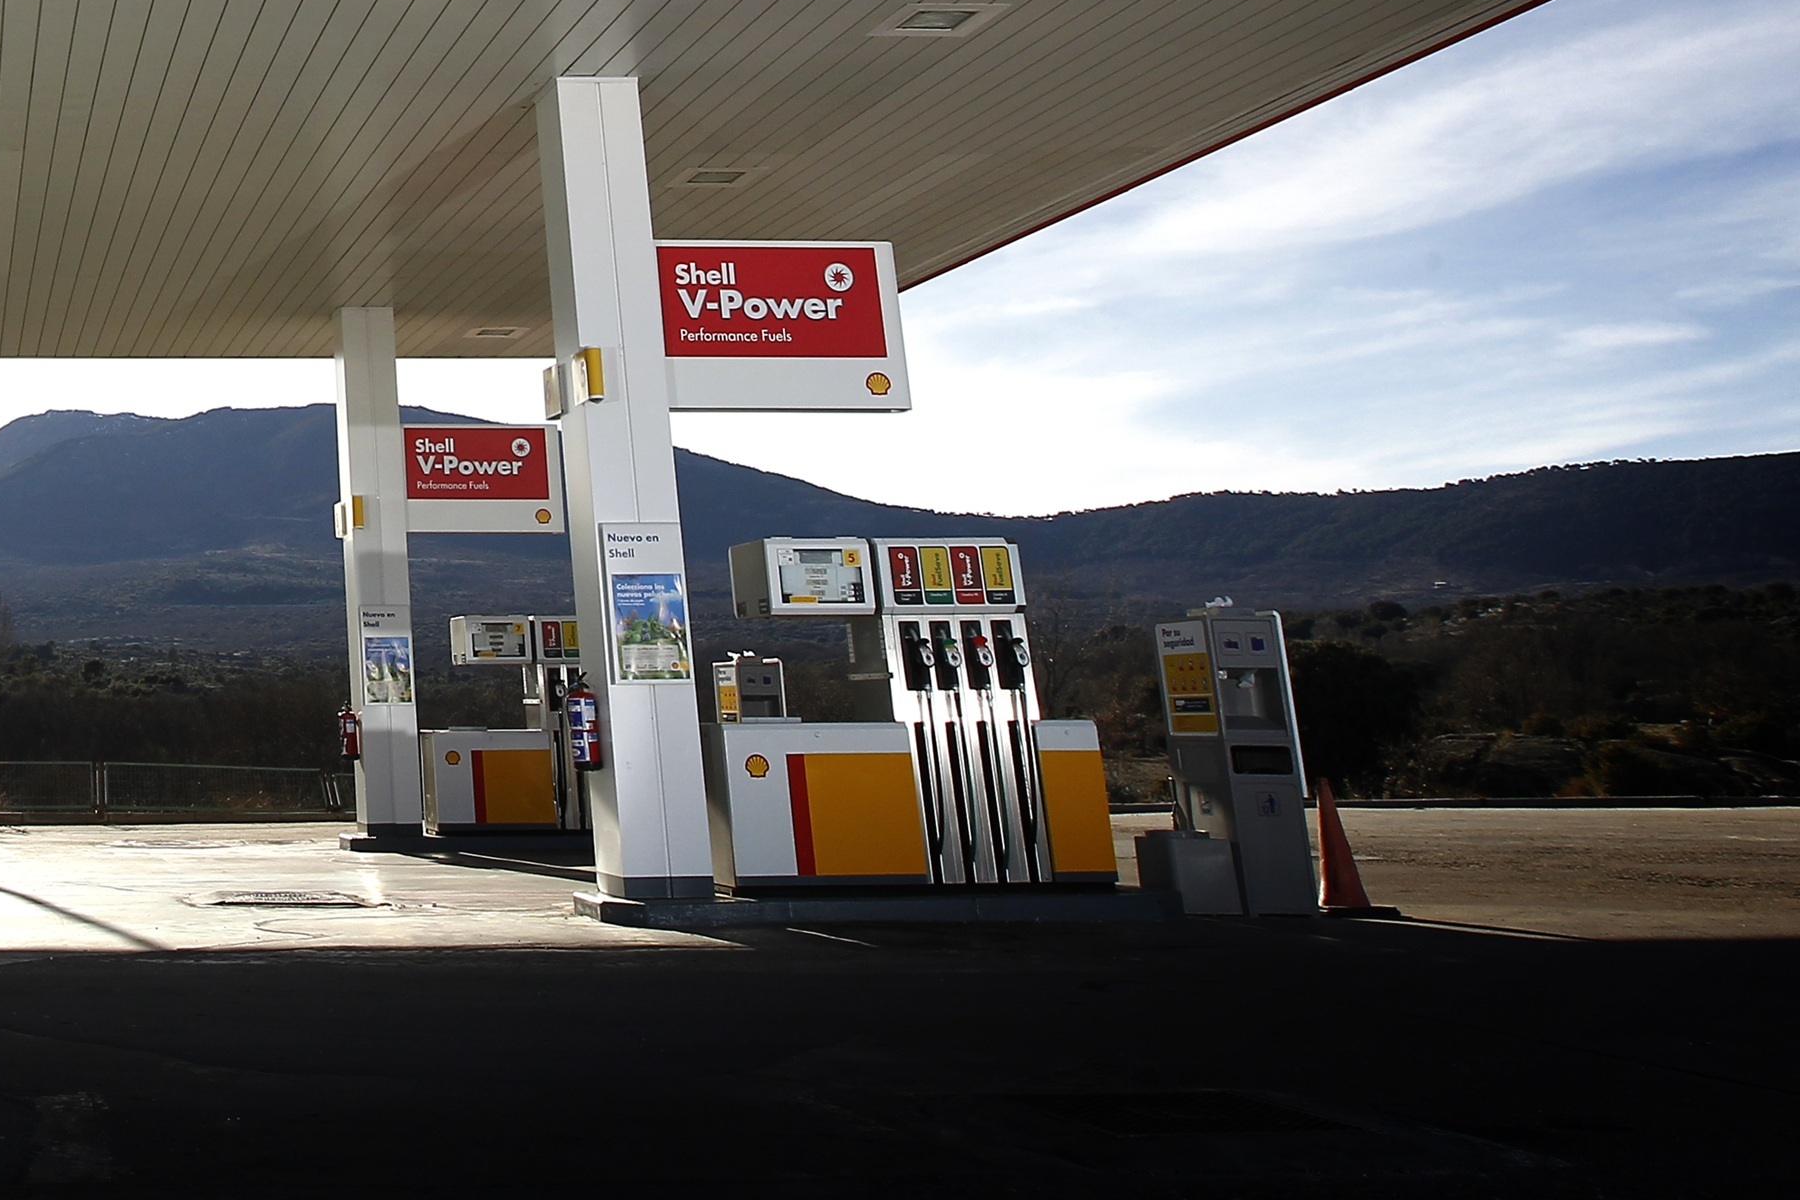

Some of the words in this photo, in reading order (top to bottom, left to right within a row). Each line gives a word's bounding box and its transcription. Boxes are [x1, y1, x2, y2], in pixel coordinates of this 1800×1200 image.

[674, 262, 736, 285] Shell
[677, 288, 843, 319] V-Power
[680, 327, 758, 342] Performance
[761, 328, 792, 342] Fuels
[415, 438, 454, 453] Shell
[416, 455, 523, 475] V-Power
[417, 480, 467, 489] Performance
[469, 481, 489, 489] Fuels
[608, 533, 643, 543] Nuevo
[646, 535, 659, 543] en
[609, 548, 635, 558] Shell
[848, 553, 855, 563] 5
